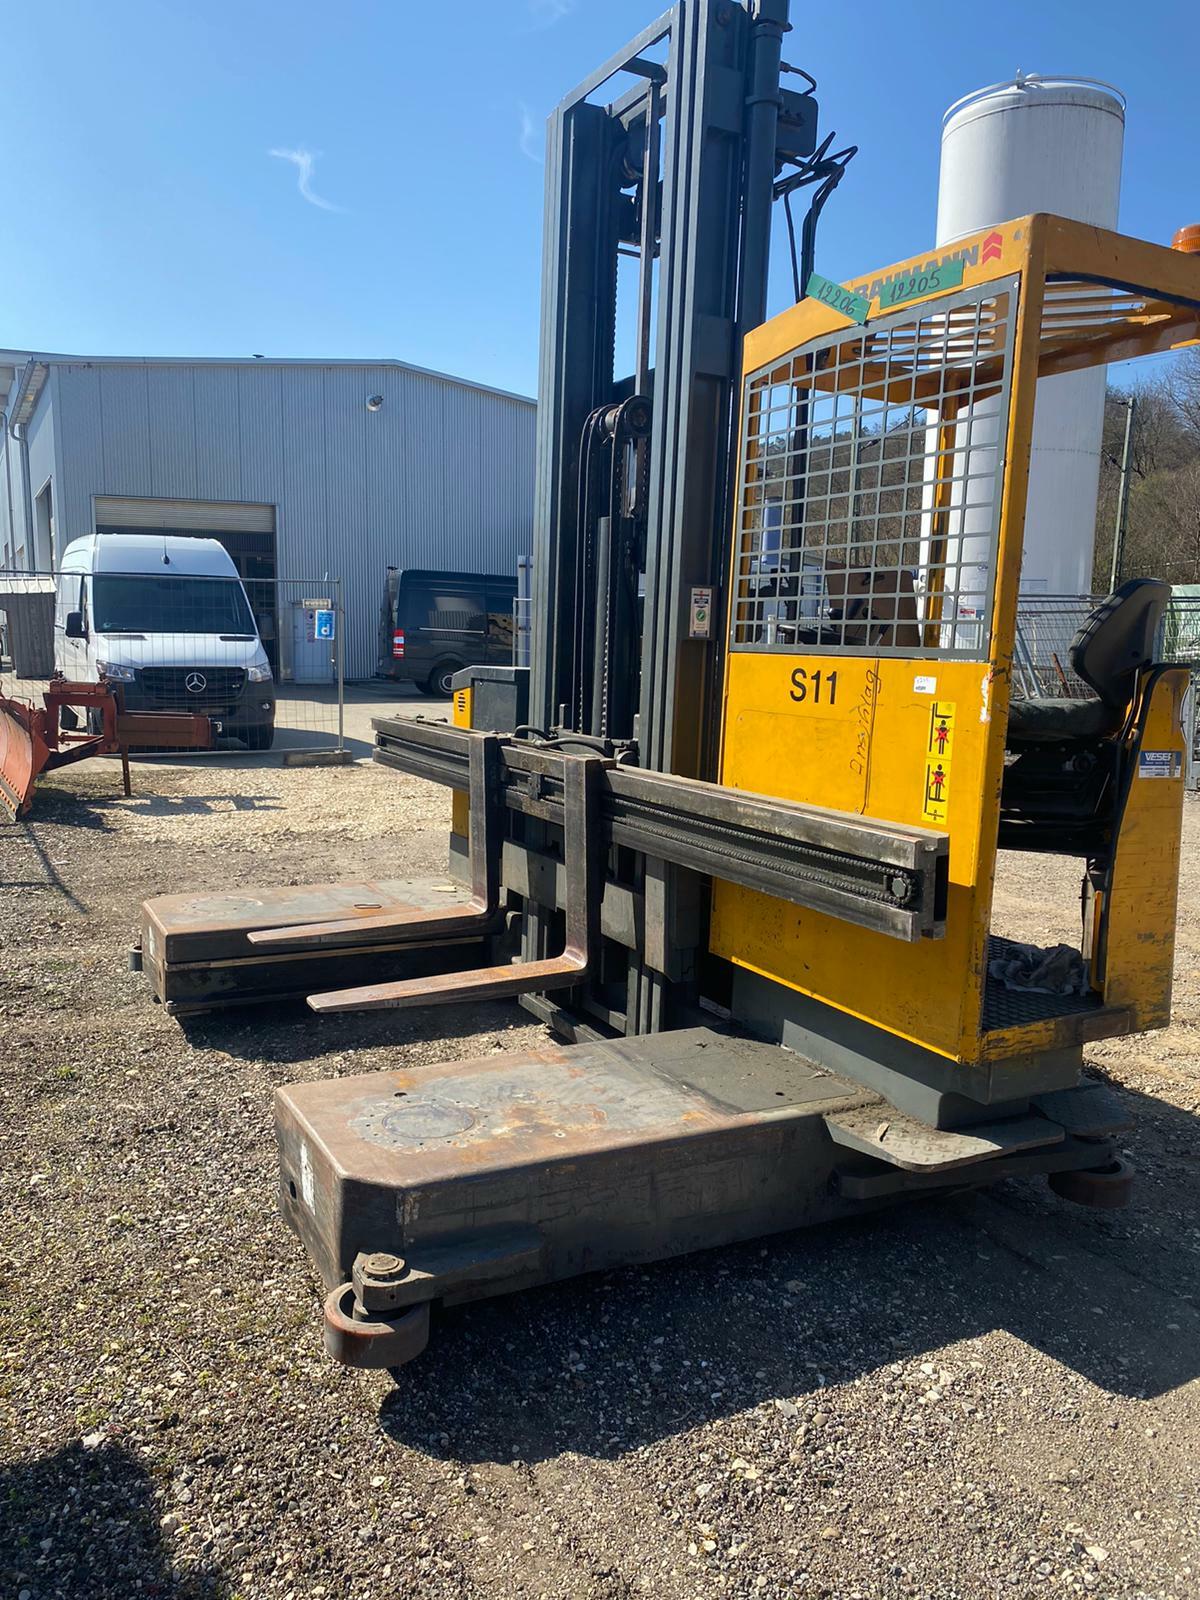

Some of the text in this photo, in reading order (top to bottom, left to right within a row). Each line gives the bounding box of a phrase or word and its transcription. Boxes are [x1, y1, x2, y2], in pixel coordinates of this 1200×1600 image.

[817, 281, 858, 315] 12206
[890, 269, 940, 303] 12205
[790, 667, 837, 705] S11
